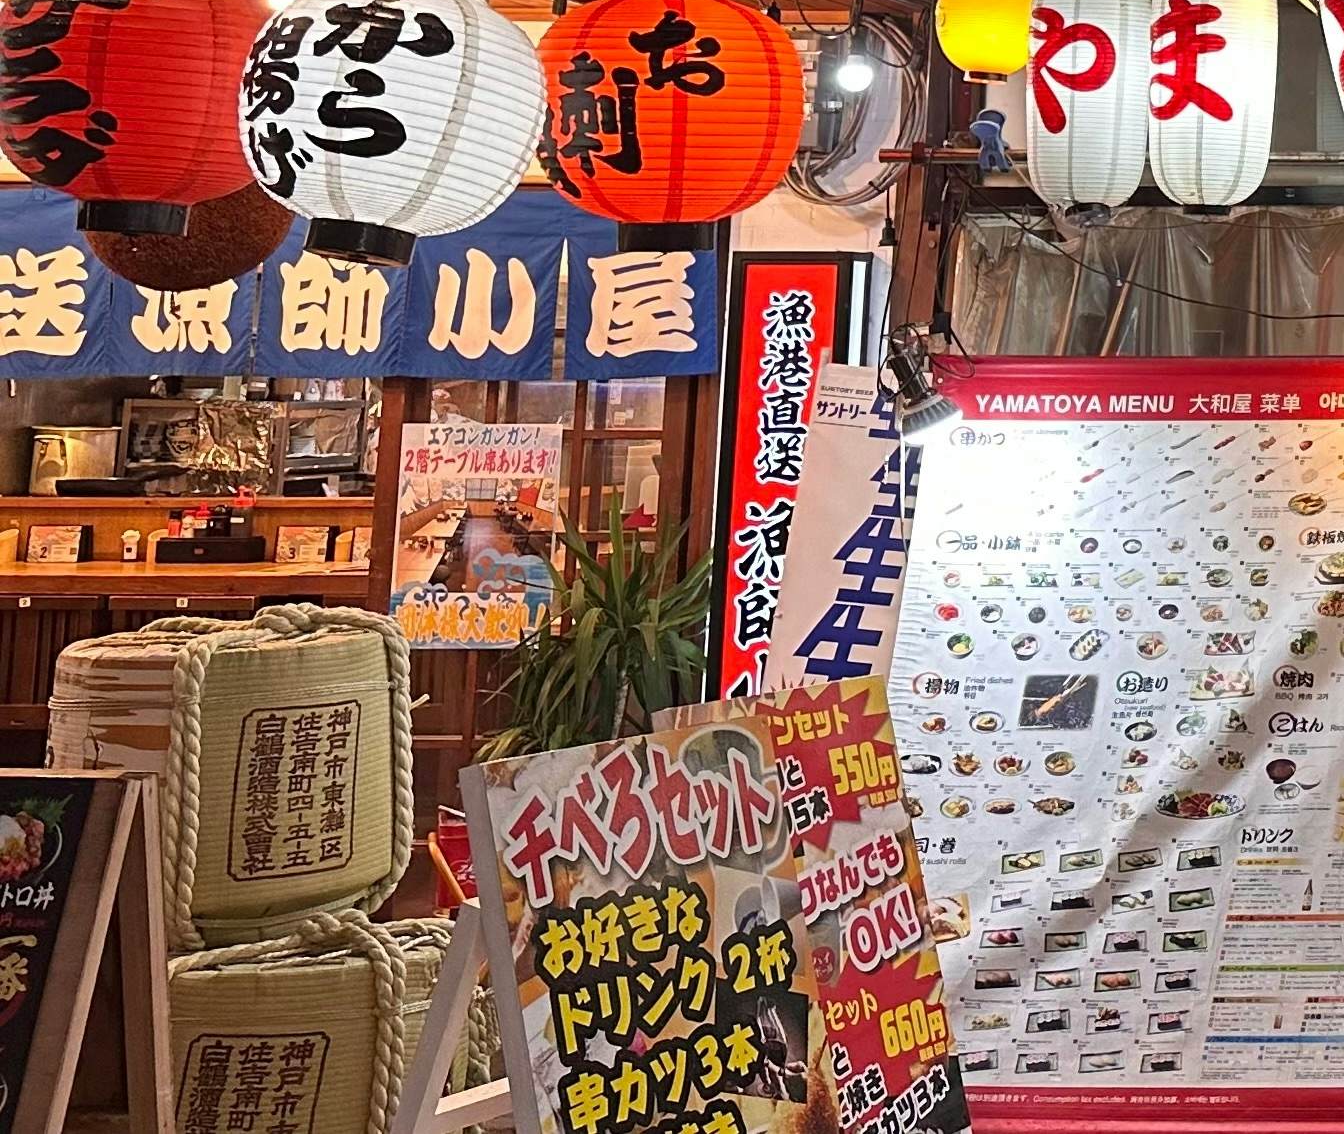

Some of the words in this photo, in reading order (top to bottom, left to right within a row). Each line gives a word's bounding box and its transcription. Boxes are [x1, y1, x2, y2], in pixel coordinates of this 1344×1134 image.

[757, 290, 817, 485] 漁港直送
[816, 400, 867, 420] サントリー
[976, 393, 1102, 414] YAMATOYA
[1108, 393, 1175, 413] MENU
[1188, 393, 1252, 414] 大和屋
[1260, 393, 1302, 413] 菜单
[427, 426, 541, 446] エアコンガンガン!
[403, 448, 557, 475] 2階テーブル席あります!
[1280, 670, 1314, 689] 焼肉
[828, 741, 898, 796] 550円
[540, 886, 707, 980] お好きな
[849, 891, 918, 965] OK!
[557, 954, 713, 1055] ドリンク
[729, 928, 793, 994] 2杯
[825, 987, 878, 1032] セット
[879, 998, 946, 1058] 660円
[566, 1022, 760, 1134] 串カツ3本
